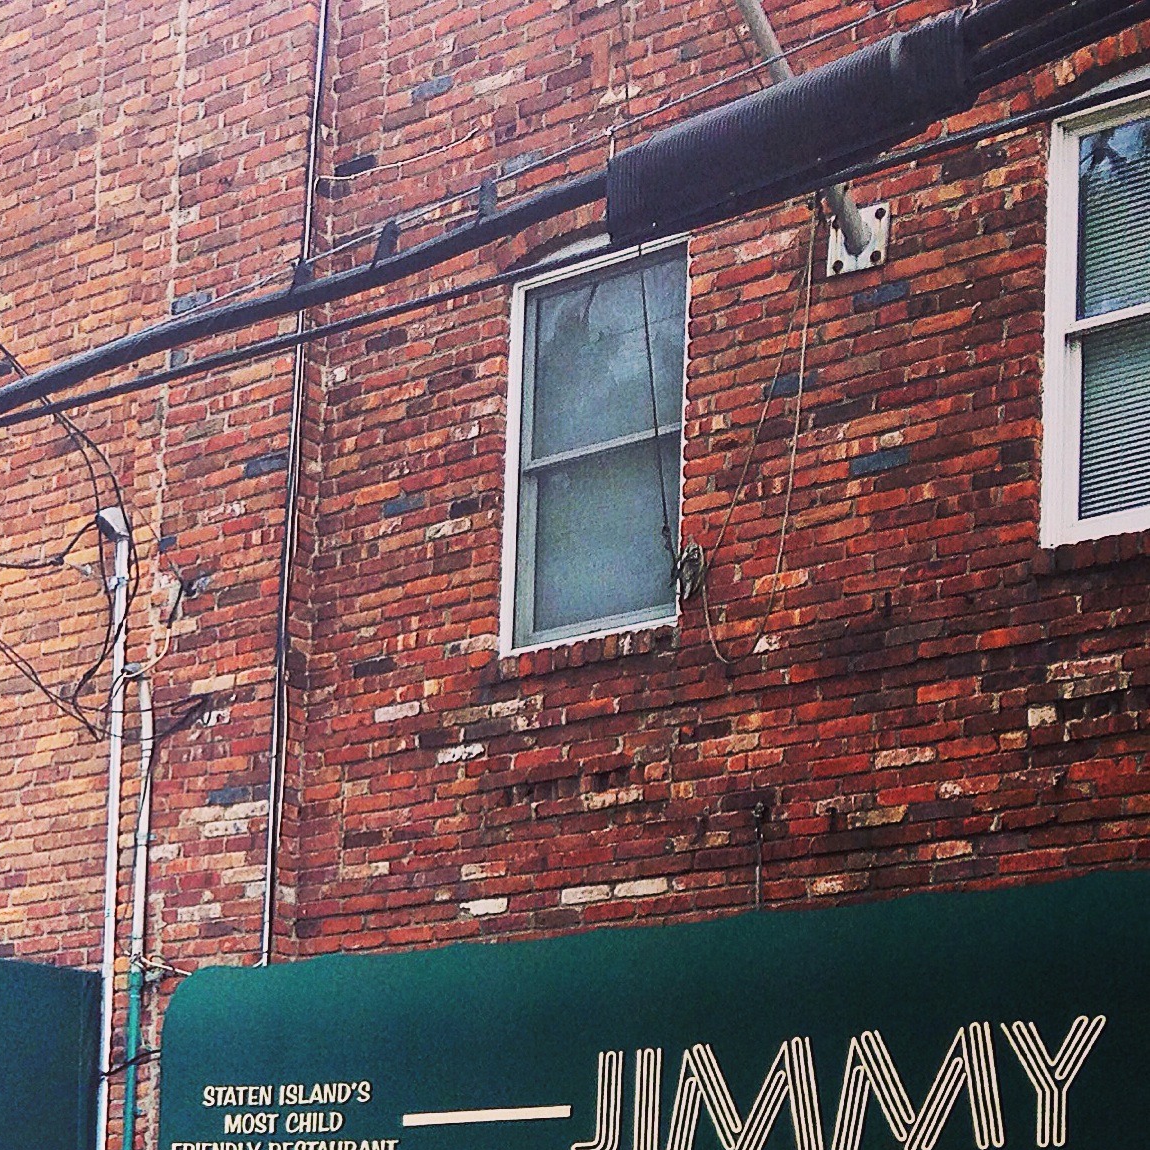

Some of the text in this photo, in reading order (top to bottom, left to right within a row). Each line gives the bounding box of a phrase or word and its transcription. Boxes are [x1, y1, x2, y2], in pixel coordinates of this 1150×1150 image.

[202, 1081, 372, 1107] STATEN ISLAND'S
[224, 1112, 344, 1135] MOST CHILD
